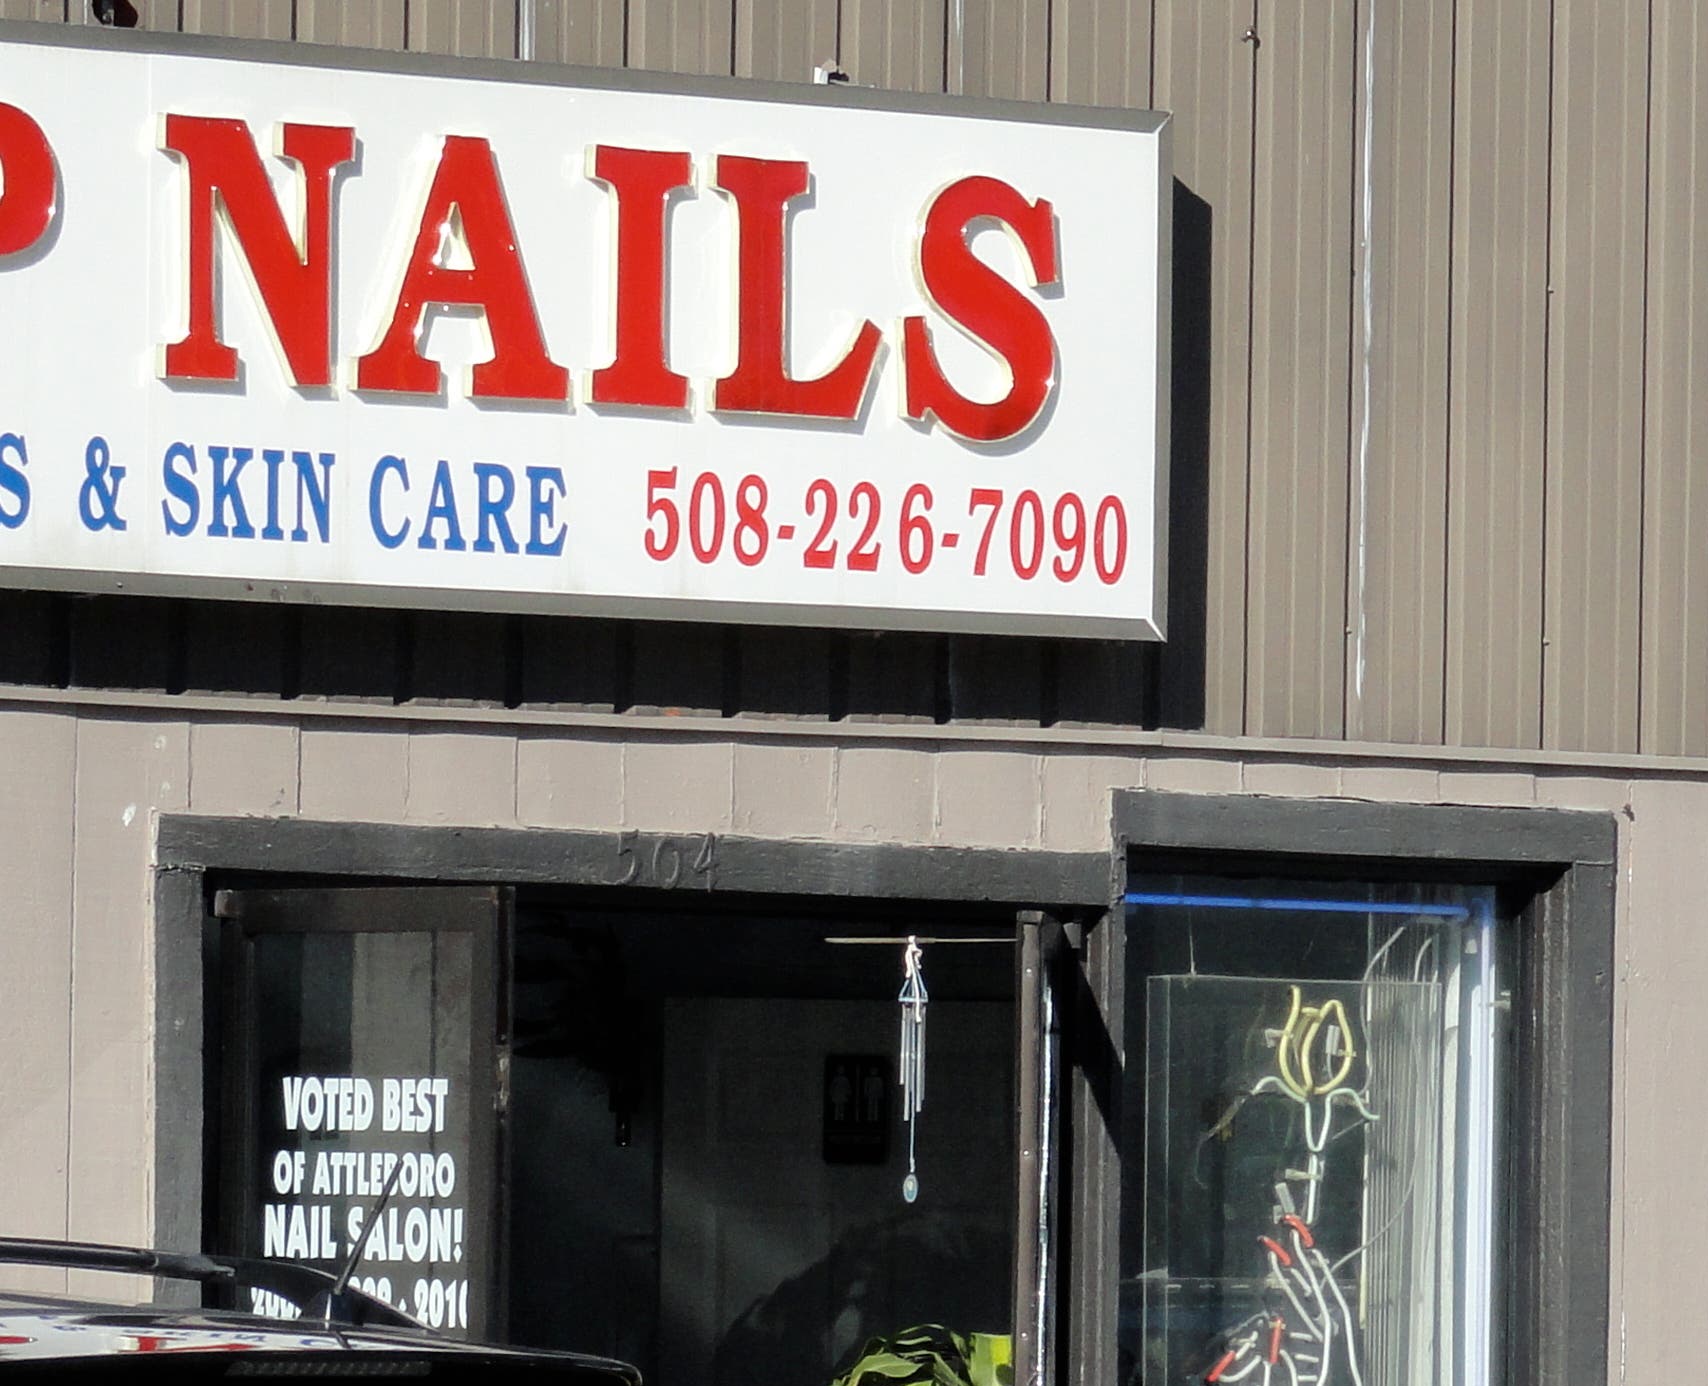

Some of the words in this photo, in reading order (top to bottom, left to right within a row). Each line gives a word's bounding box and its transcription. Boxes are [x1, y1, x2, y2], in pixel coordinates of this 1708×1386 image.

[156, 112, 1063, 442] NAILS
[80, 436, 127, 532] &
[162, 441, 335, 543] SKIN
[369, 455, 568, 556] CARE
[644, 467, 1127, 584] 508-226-7090
[612, 828, 717, 892] 504
[282, 1076, 373, 1132] VOTED
[383, 1077, 449, 1133] BEST
[273, 1150, 305, 1196] OF
[312, 1151, 455, 1198] ATTLEBORO
[263, 1204, 337, 1259] NAIL
[347, 1206, 464, 1263] SALON!
